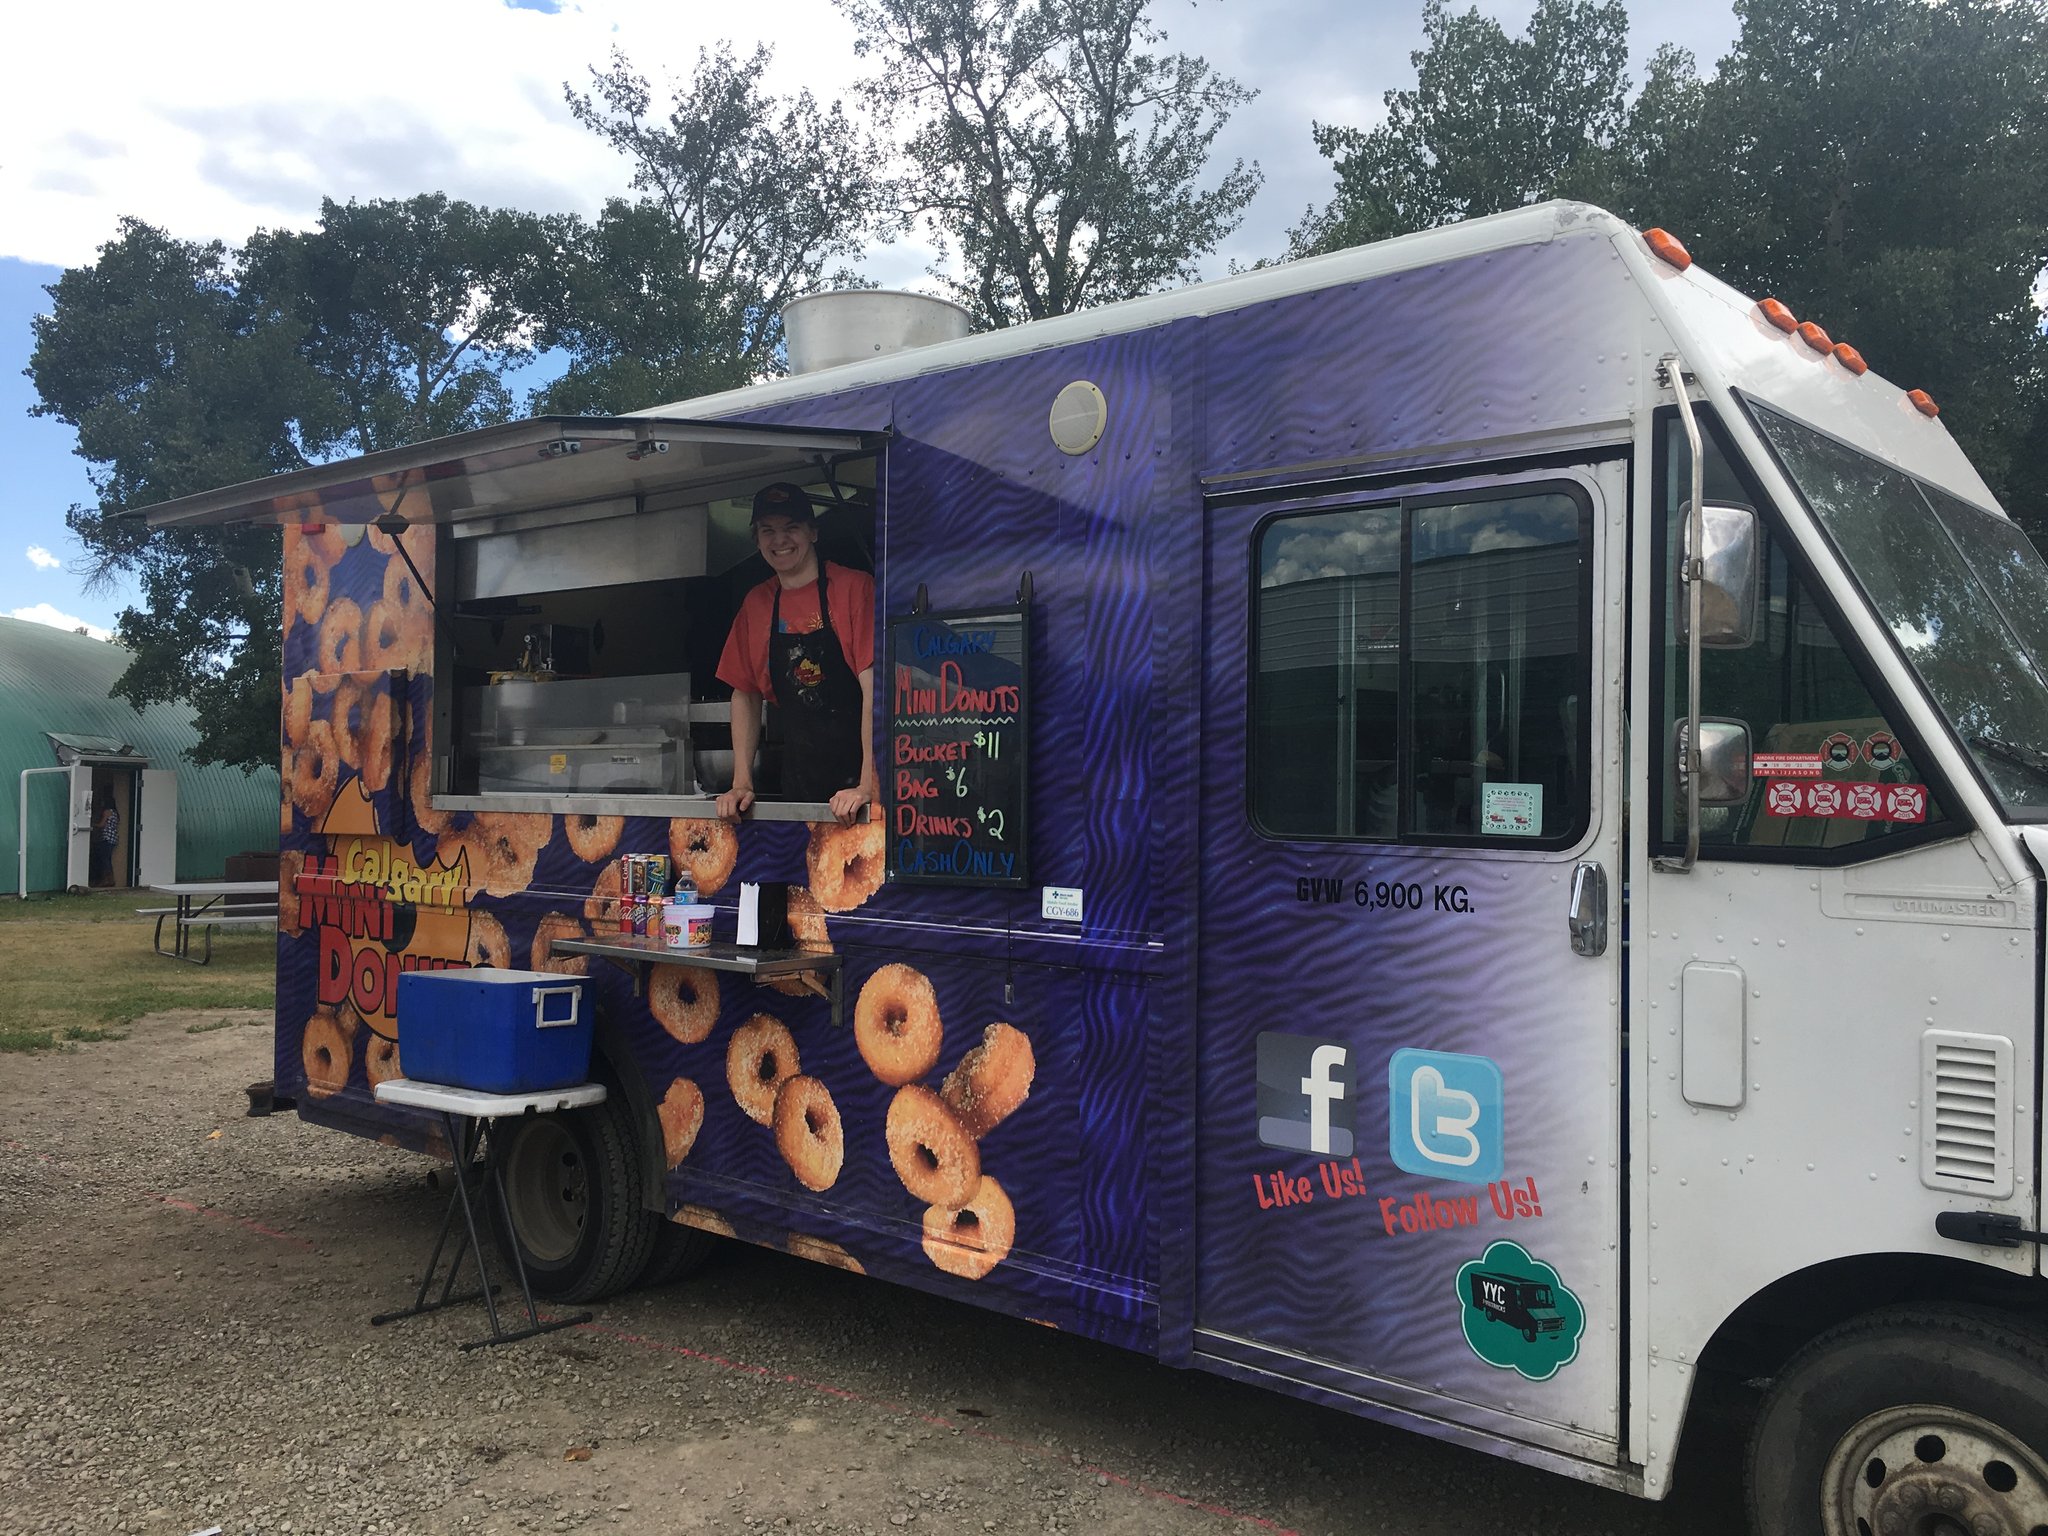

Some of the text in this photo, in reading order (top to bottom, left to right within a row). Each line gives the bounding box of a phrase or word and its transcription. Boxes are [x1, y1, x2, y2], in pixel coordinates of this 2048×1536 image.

[895, 660, 1021, 716] MINI DONUTS
[895, 733, 972, 766] BUCKET
[896, 765, 968, 801] BAG $6
[896, 805, 1004, 842] DRINKS $2
[342, 837, 464, 917] Calgary
[1296, 876, 1475, 913] GVW 6,900 KG.
[295, 853, 394, 941] MINI
[1046, 905, 1079, 918] CGY-686
[1893, 900, 1998, 917] UTILIMASTER
[1254, 1157, 1367, 1210] Like Us!
[1378, 1176, 1543, 1237] Follow Us!
[1482, 1280, 1506, 1305] YYC
